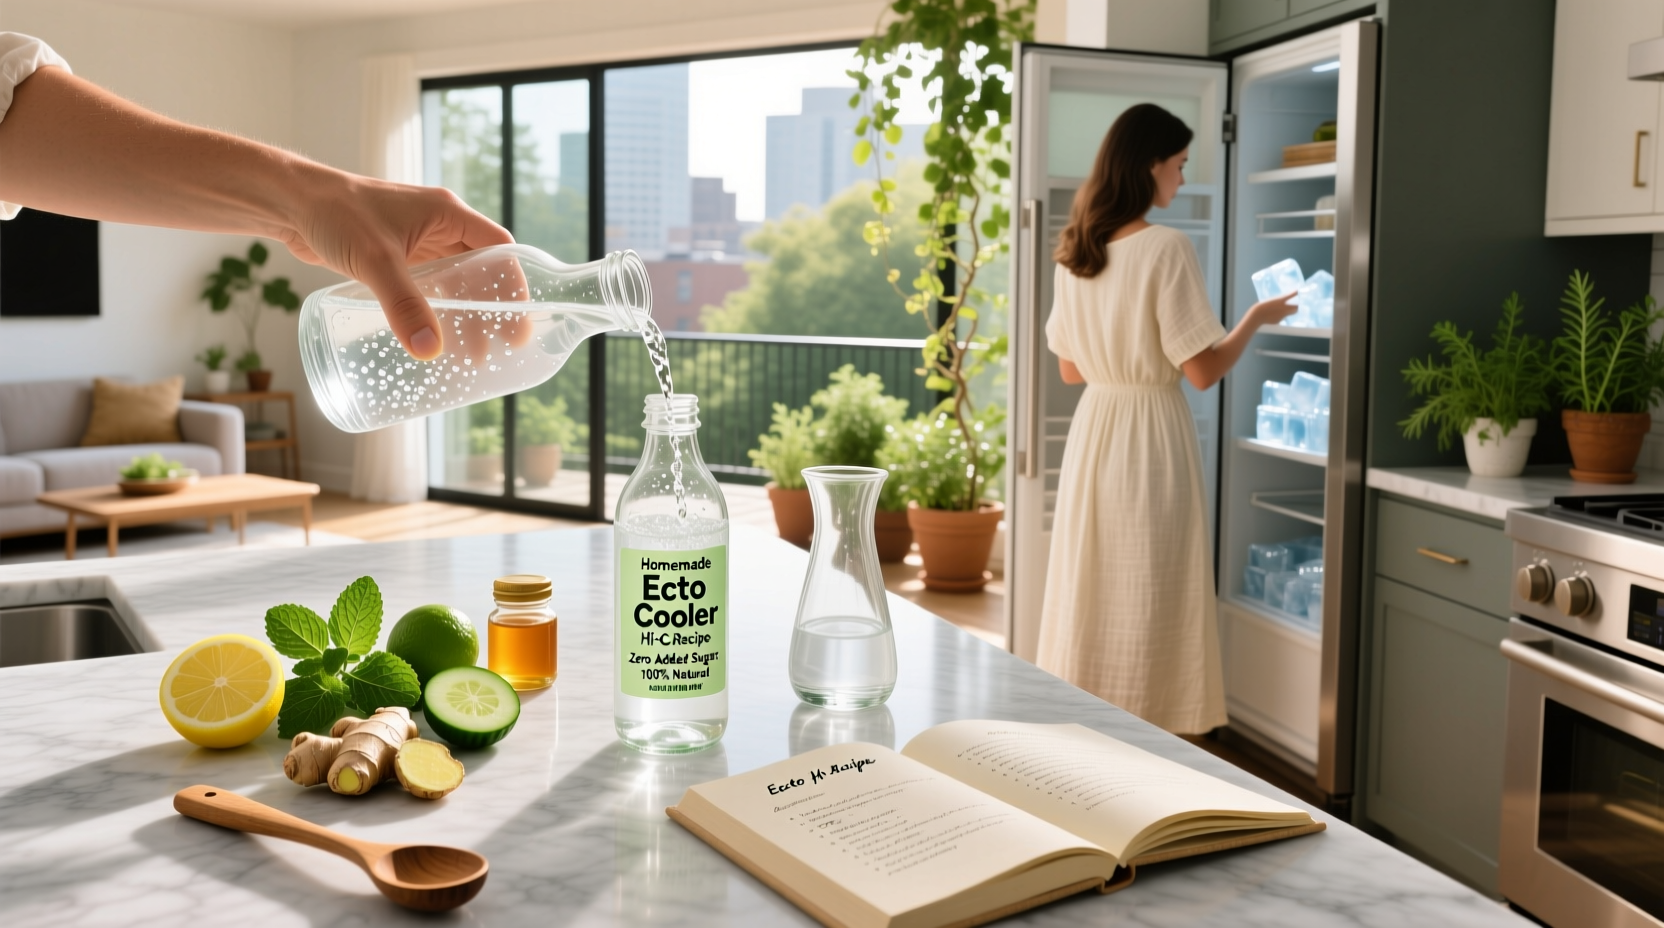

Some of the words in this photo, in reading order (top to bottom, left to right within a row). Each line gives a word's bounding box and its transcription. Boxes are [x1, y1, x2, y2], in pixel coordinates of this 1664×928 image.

[641, 556, 711, 571] Homemade
[643, 574, 706, 601] Ecto
[634, 602, 719, 628] Cooler
[672, 631, 711, 647] Recipe
[629, 652, 651, 664] Zero
[641, 668, 669, 680] 100%
[672, 667, 710, 680] Natural
